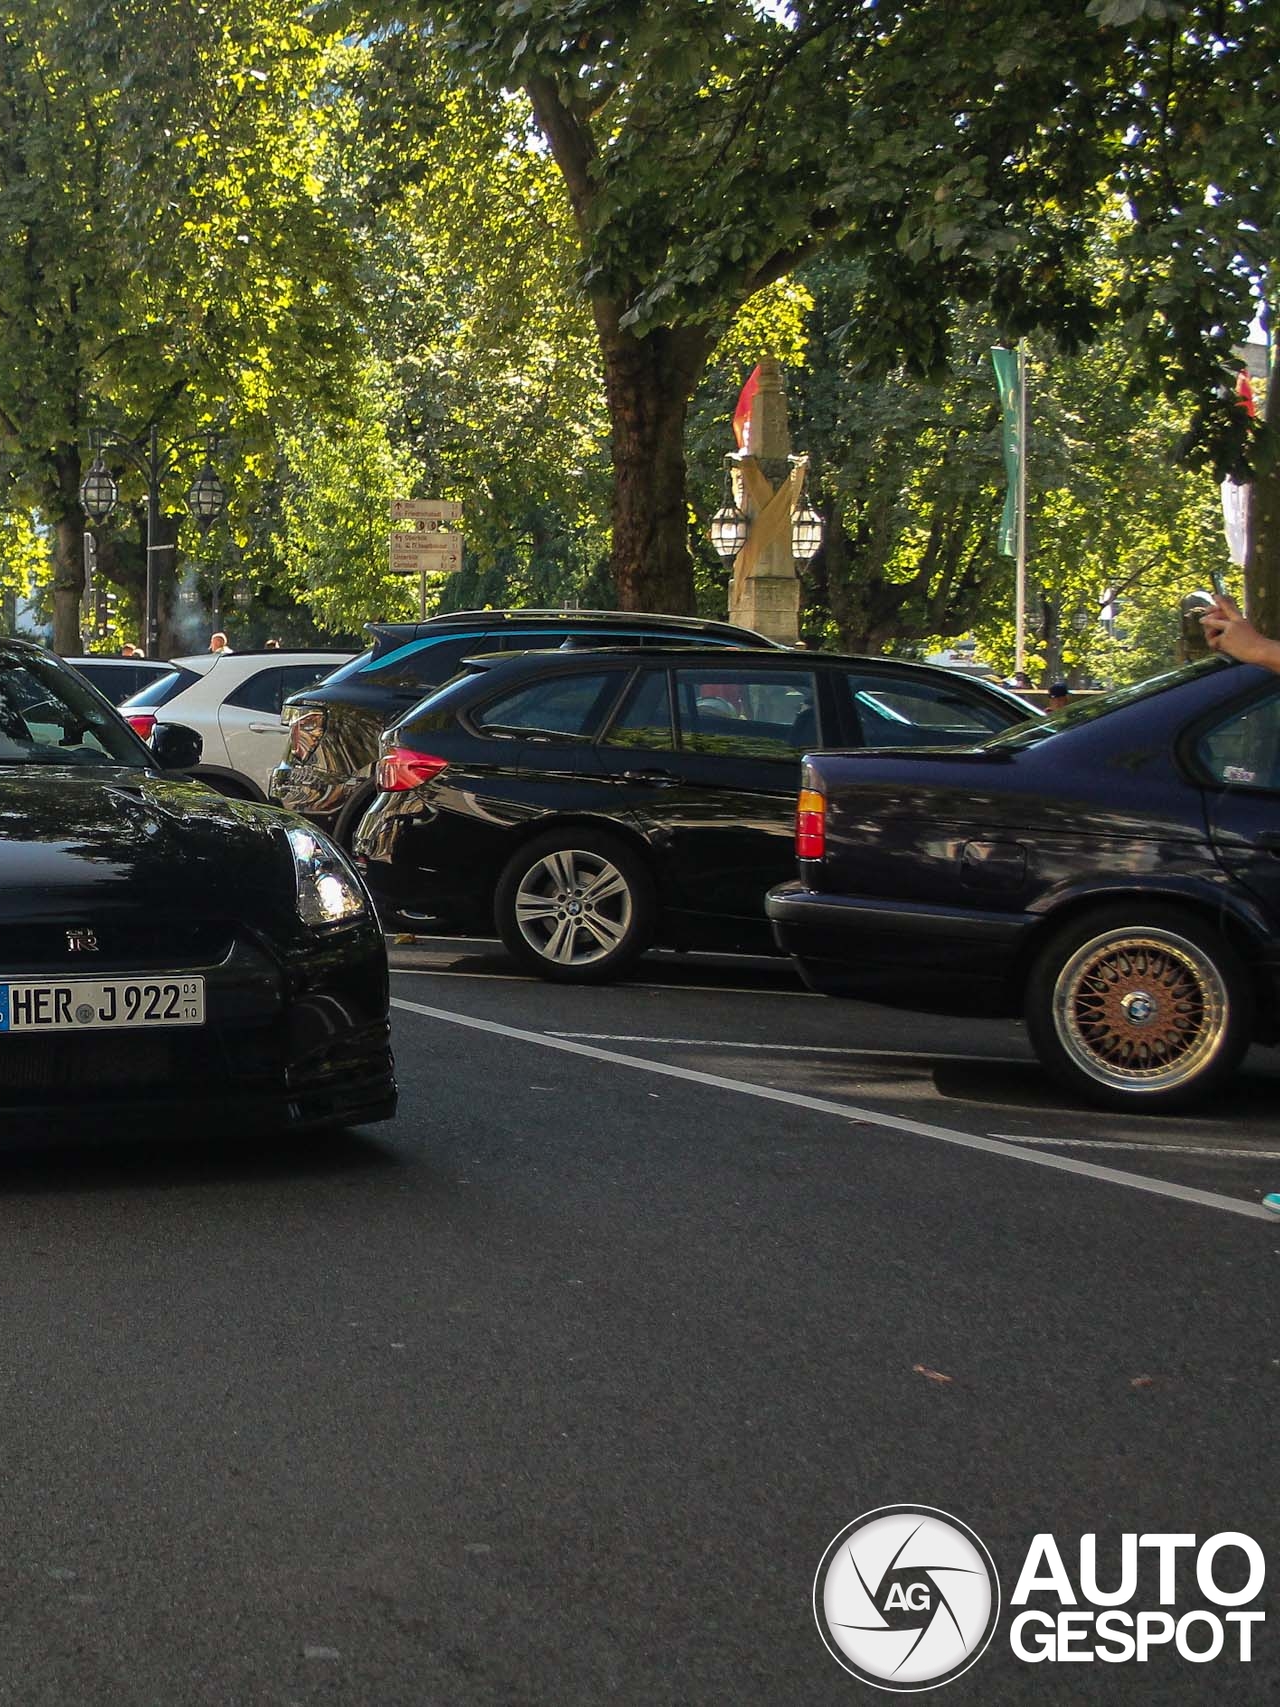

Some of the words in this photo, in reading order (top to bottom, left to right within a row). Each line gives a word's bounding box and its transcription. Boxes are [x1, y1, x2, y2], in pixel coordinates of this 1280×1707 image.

[183, 983, 198, 995] 03
[12, 988, 73, 1025] HER
[183, 1007, 198, 1018] 10
